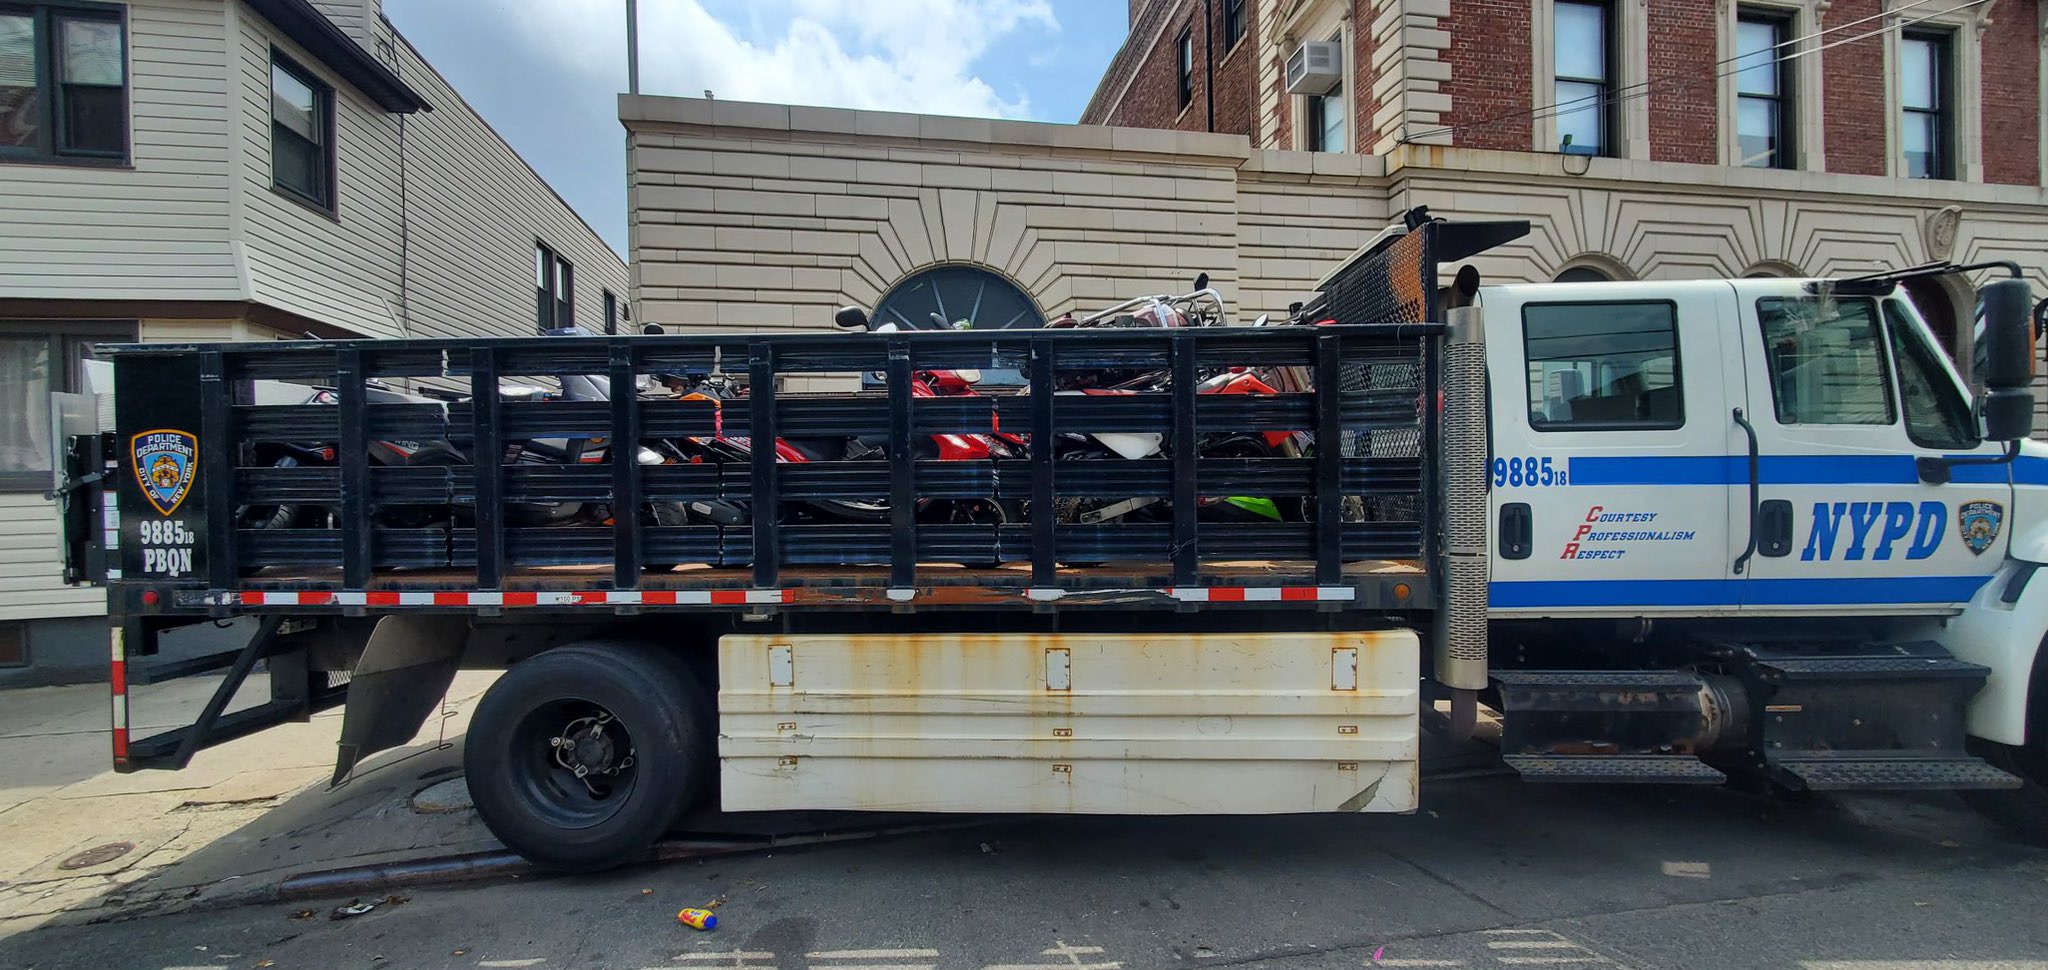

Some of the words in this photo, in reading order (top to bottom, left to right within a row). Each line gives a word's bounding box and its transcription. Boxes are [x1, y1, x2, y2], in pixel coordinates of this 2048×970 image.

[148, 434, 182, 444] POLICE
[136, 442, 193, 458] DEPARTMENT
[138, 467, 151, 487] CITY
[149, 489, 159, 501] OF
[171, 486, 184, 504] NEW
[182, 461, 194, 484] YORK
[1586, 506, 1658, 522] COURTESY
[1573, 525, 1696, 541] PROFESSIONALISM
[1800, 501, 1948, 561] NYPD
[1560, 543, 1625, 559] RESPECT
[144, 549, 192, 577] PBQN
